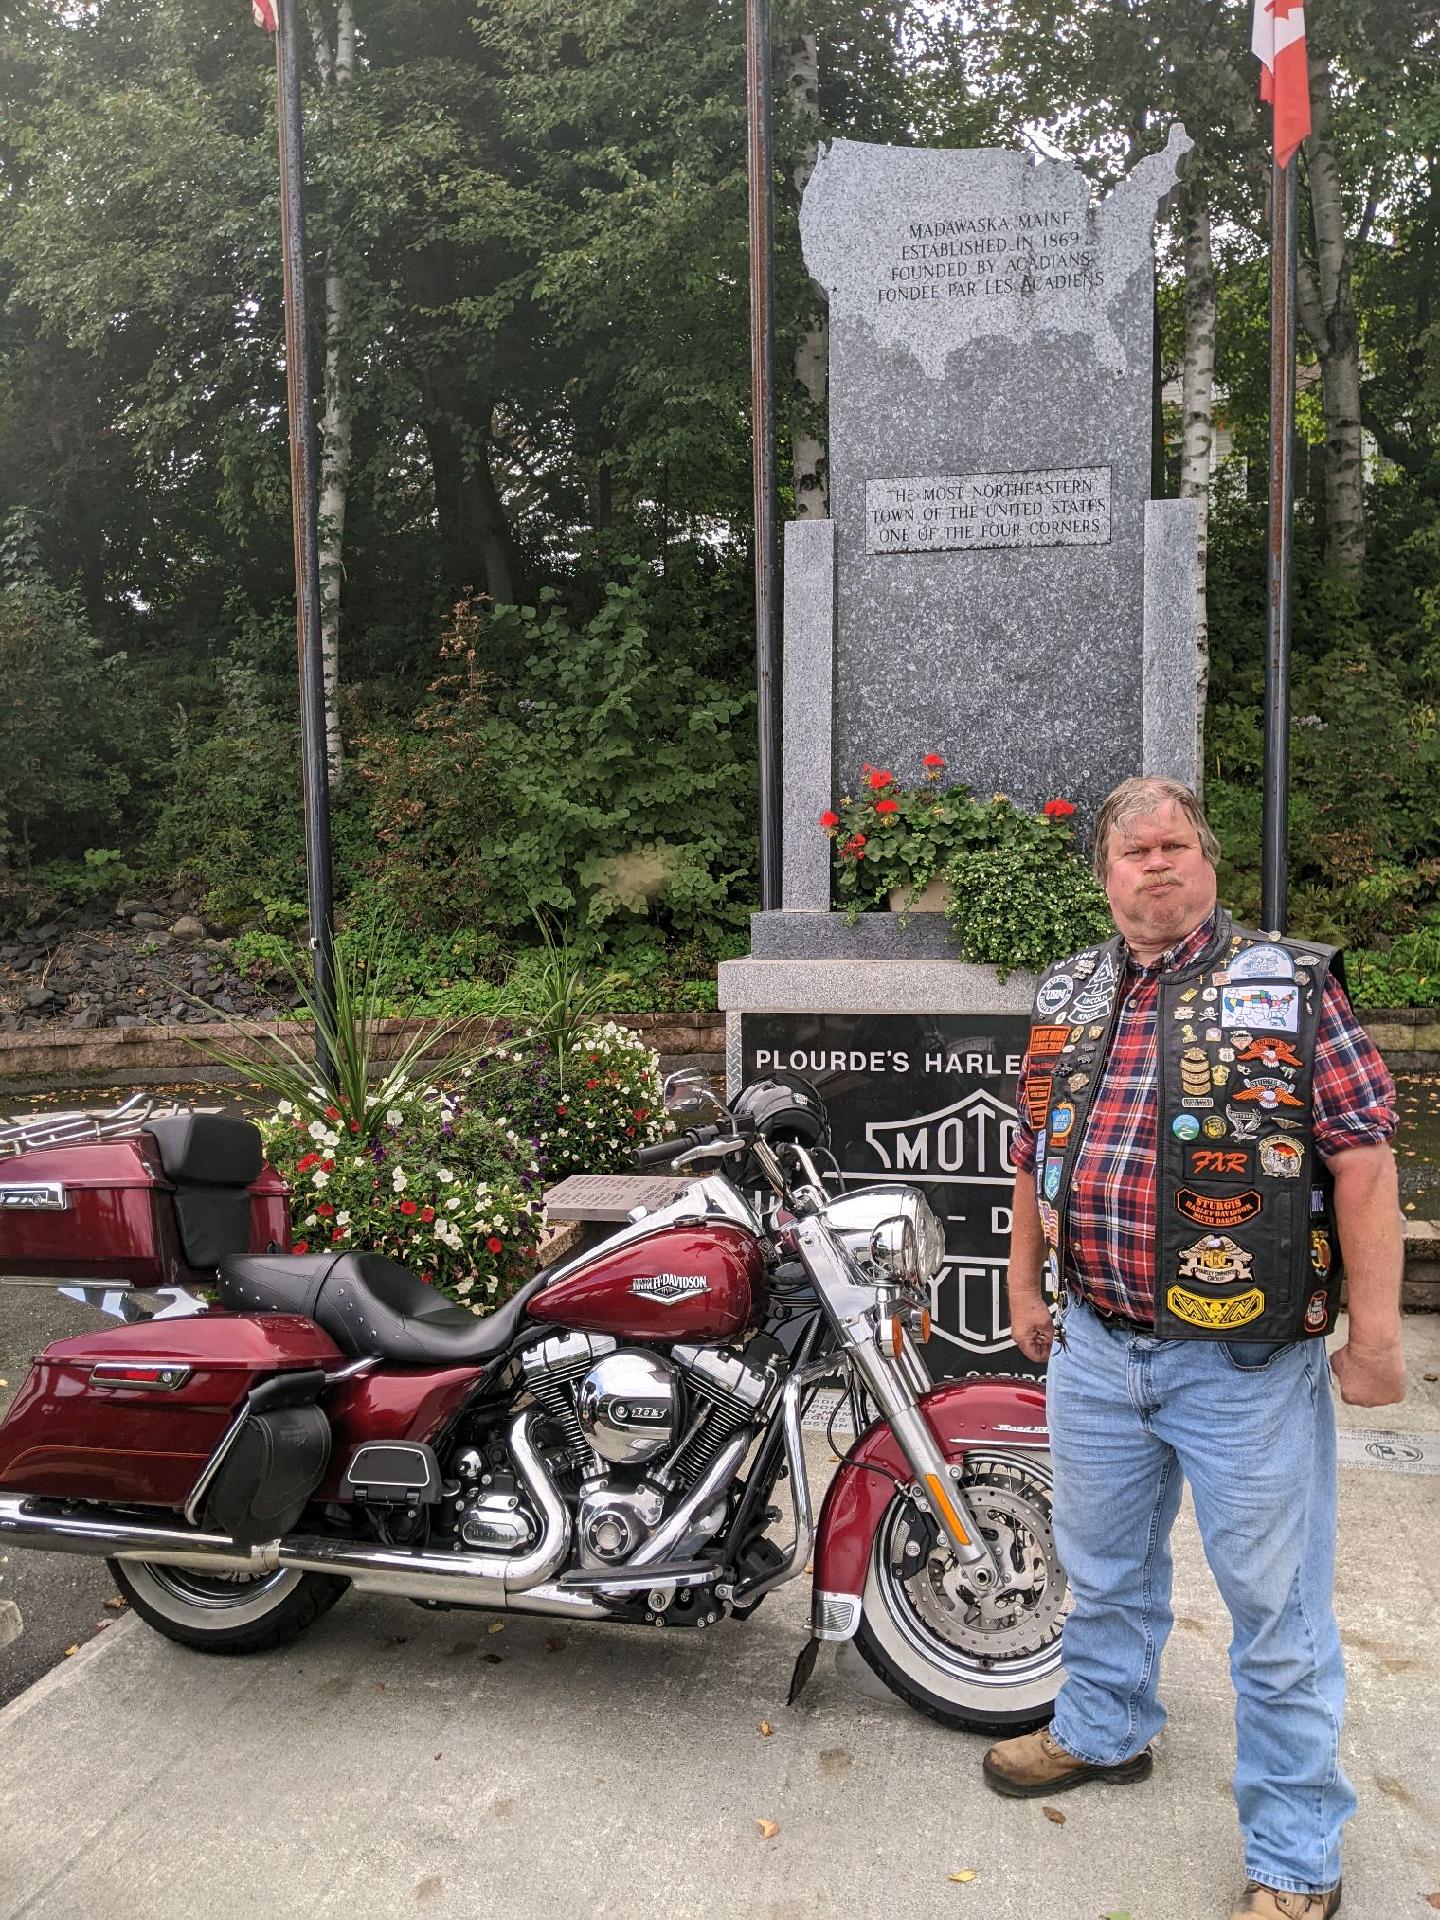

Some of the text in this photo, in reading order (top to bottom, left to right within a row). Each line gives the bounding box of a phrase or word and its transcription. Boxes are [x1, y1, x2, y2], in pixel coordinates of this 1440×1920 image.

[1018, 212, 1072, 228] MAINE
[902, 232, 1079, 260] ESTABLISHED IN 1869
[891, 252, 1091, 281] FOUNDED BY ACADIANS
[948, 281, 977, 297] PAR
[985, 278, 1013, 295] LES
[1021, 271, 1104, 297] ACADIENS
[887, 479, 1093, 502] THE MOST NORTHEASTERN
[871, 498, 1106, 524] TOWN OF THE UNITED STATES
[879, 518, 1100, 543] ONE OF THE FOUR CORNERS
[1054, 950, 1099, 971] MAINE
[756, 1050, 1021, 1075] PLOURDE'S HARLE
[896, 1103, 1018, 1174] MOTO
[1191, 1151, 1248, 1174] FXR
[1196, 1197, 1242, 1211] STURGIS
[1192, 1211, 1243, 1225] SOUTH DAKOTA
